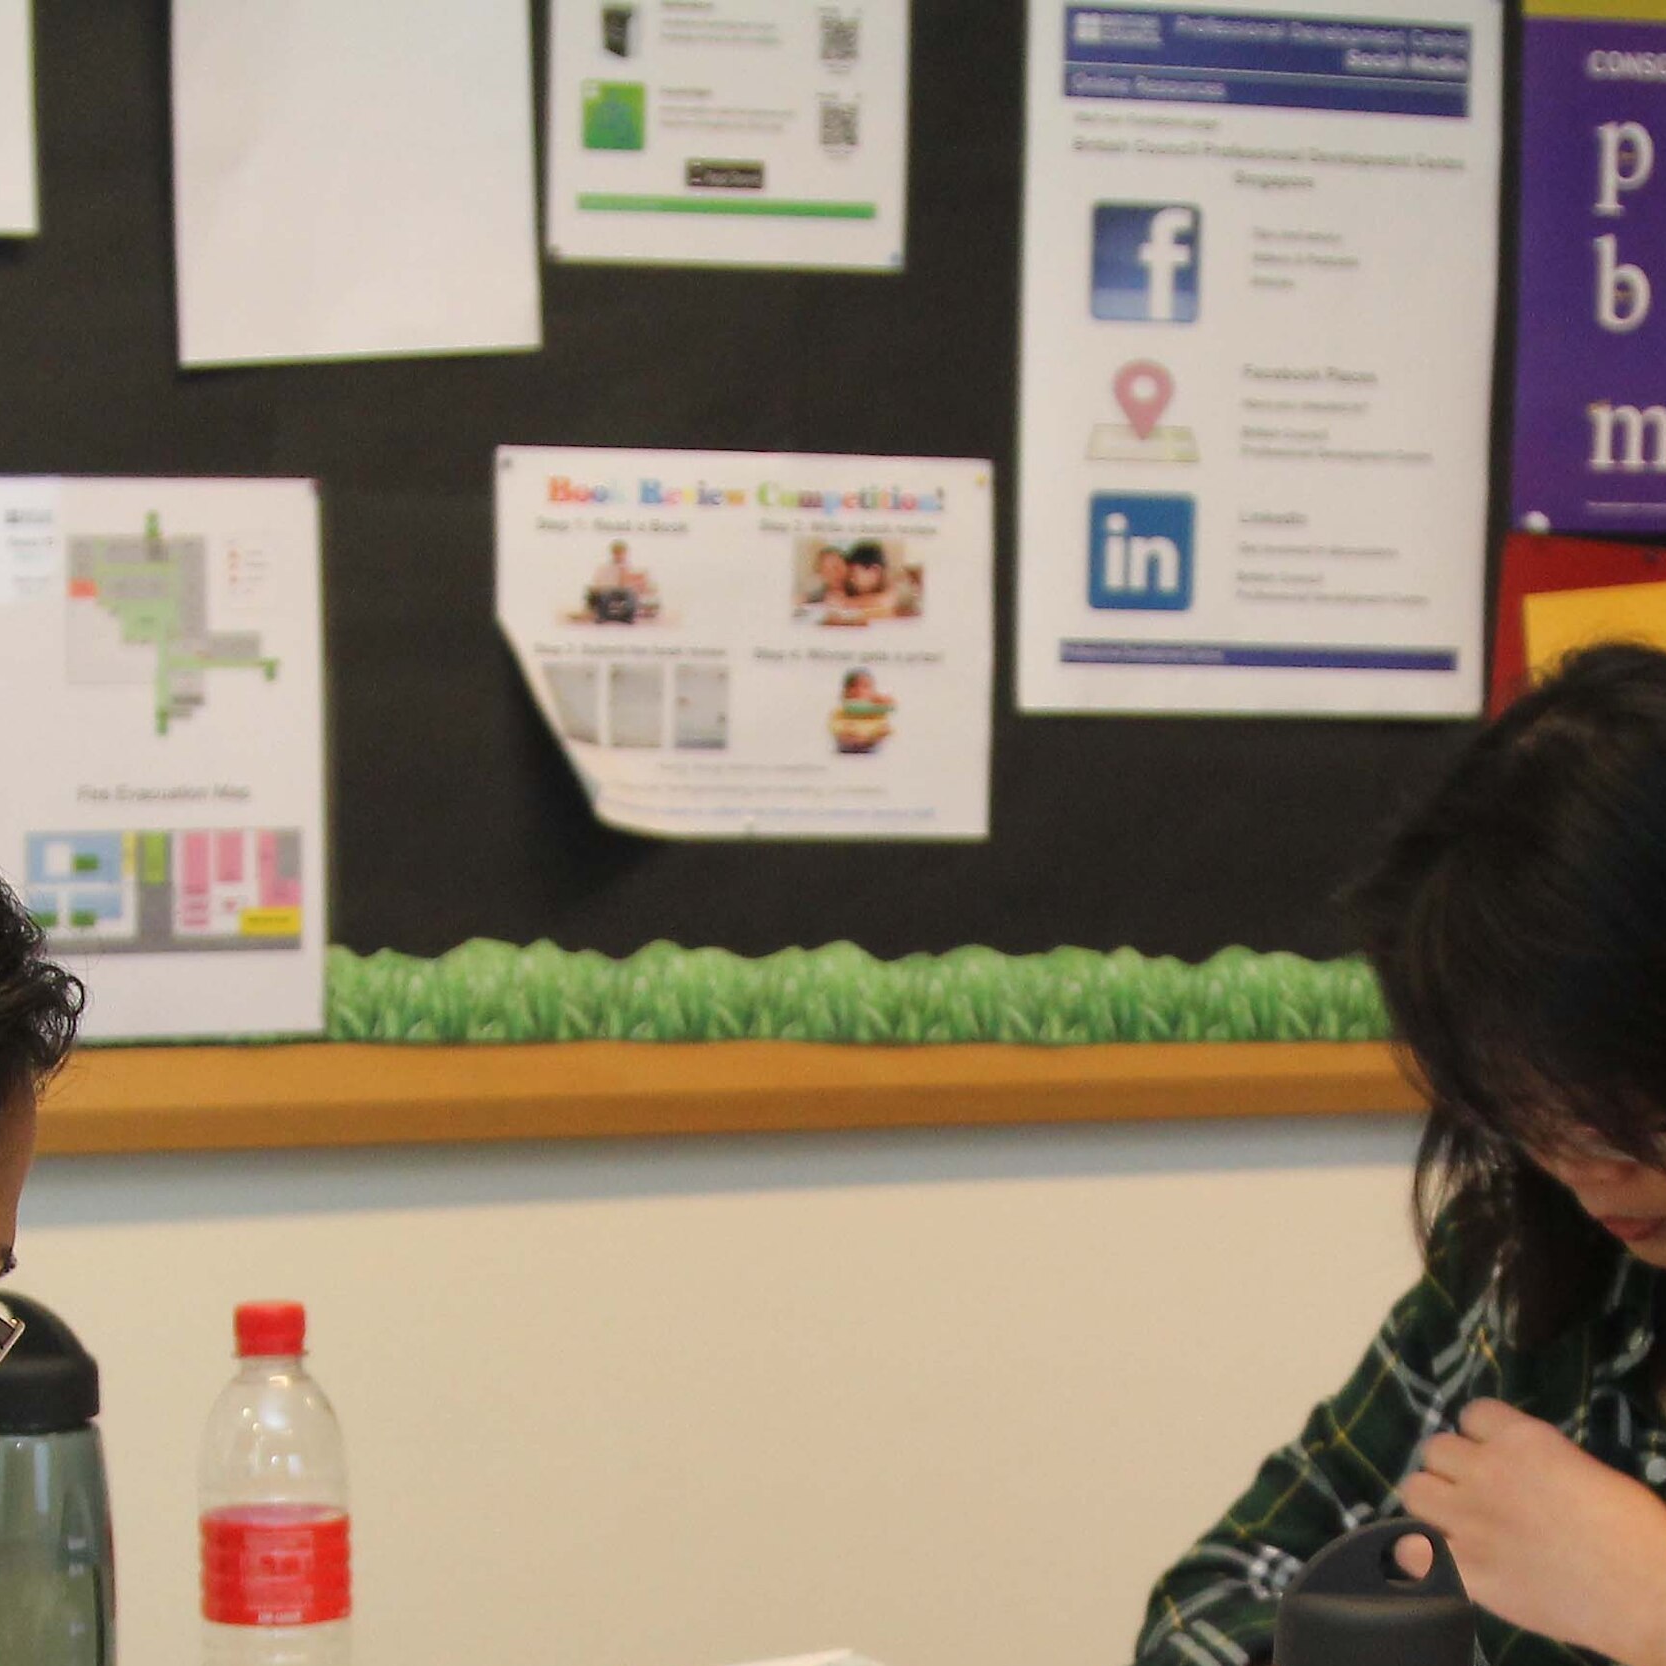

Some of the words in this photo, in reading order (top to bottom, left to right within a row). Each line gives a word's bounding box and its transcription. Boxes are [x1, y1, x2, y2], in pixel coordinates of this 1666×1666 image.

[1594, 118, 1653, 214] p
[1141, 208, 1194, 319] f
[1595, 235, 1650, 332] b
[547, 476, 623, 504] Book
[638, 478, 747, 507] Review
[757, 481, 945, 514] Competition!
[1103, 512, 1180, 592] in
